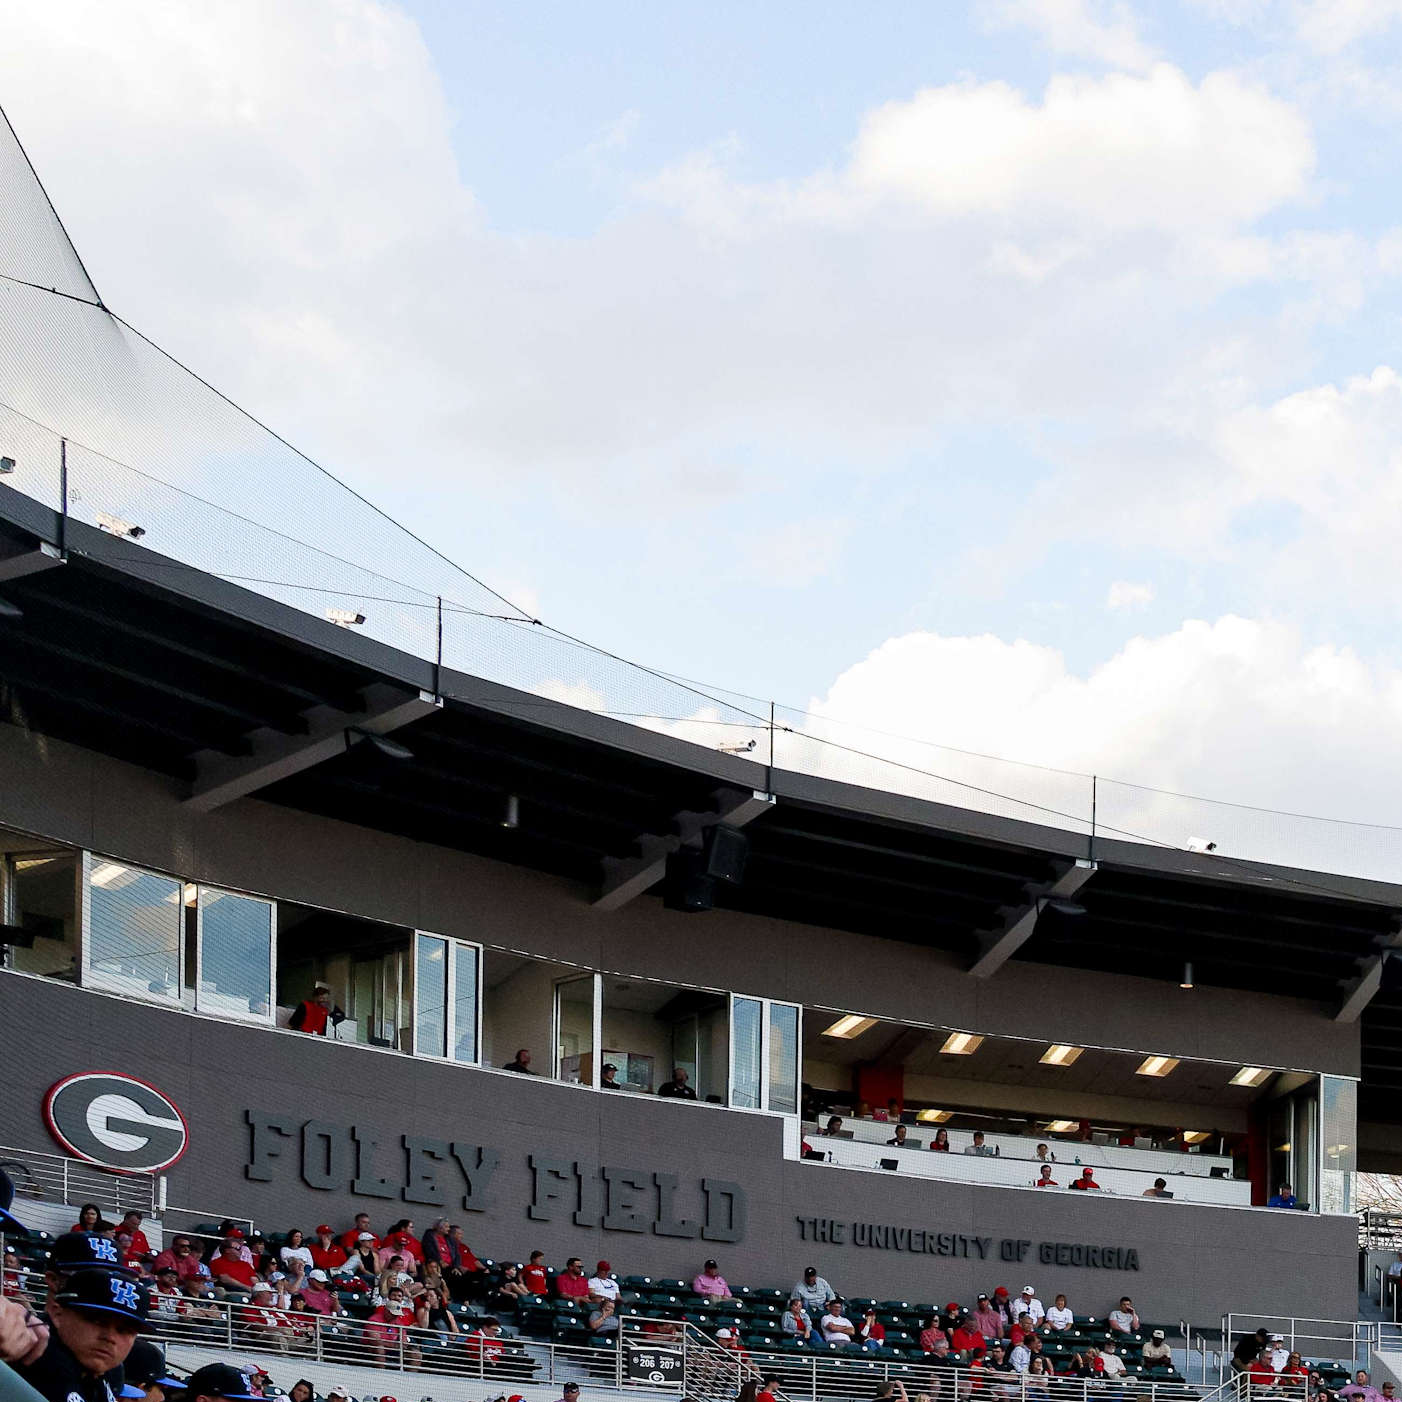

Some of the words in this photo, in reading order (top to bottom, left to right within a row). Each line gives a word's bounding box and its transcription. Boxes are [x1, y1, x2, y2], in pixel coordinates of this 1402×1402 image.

[245, 1109, 501, 1212] FOLEY
[528, 1154, 749, 1243] FIELD
[796, 1216, 845, 1244] THE
[853, 1222, 991, 1260] UNIVERSITY
[1000, 1238, 1031, 1262] OF
[1039, 1242, 1140, 1271] GEORGIA
[640, 1359, 655, 1368] 206
[660, 1360, 674, 1369] 207
